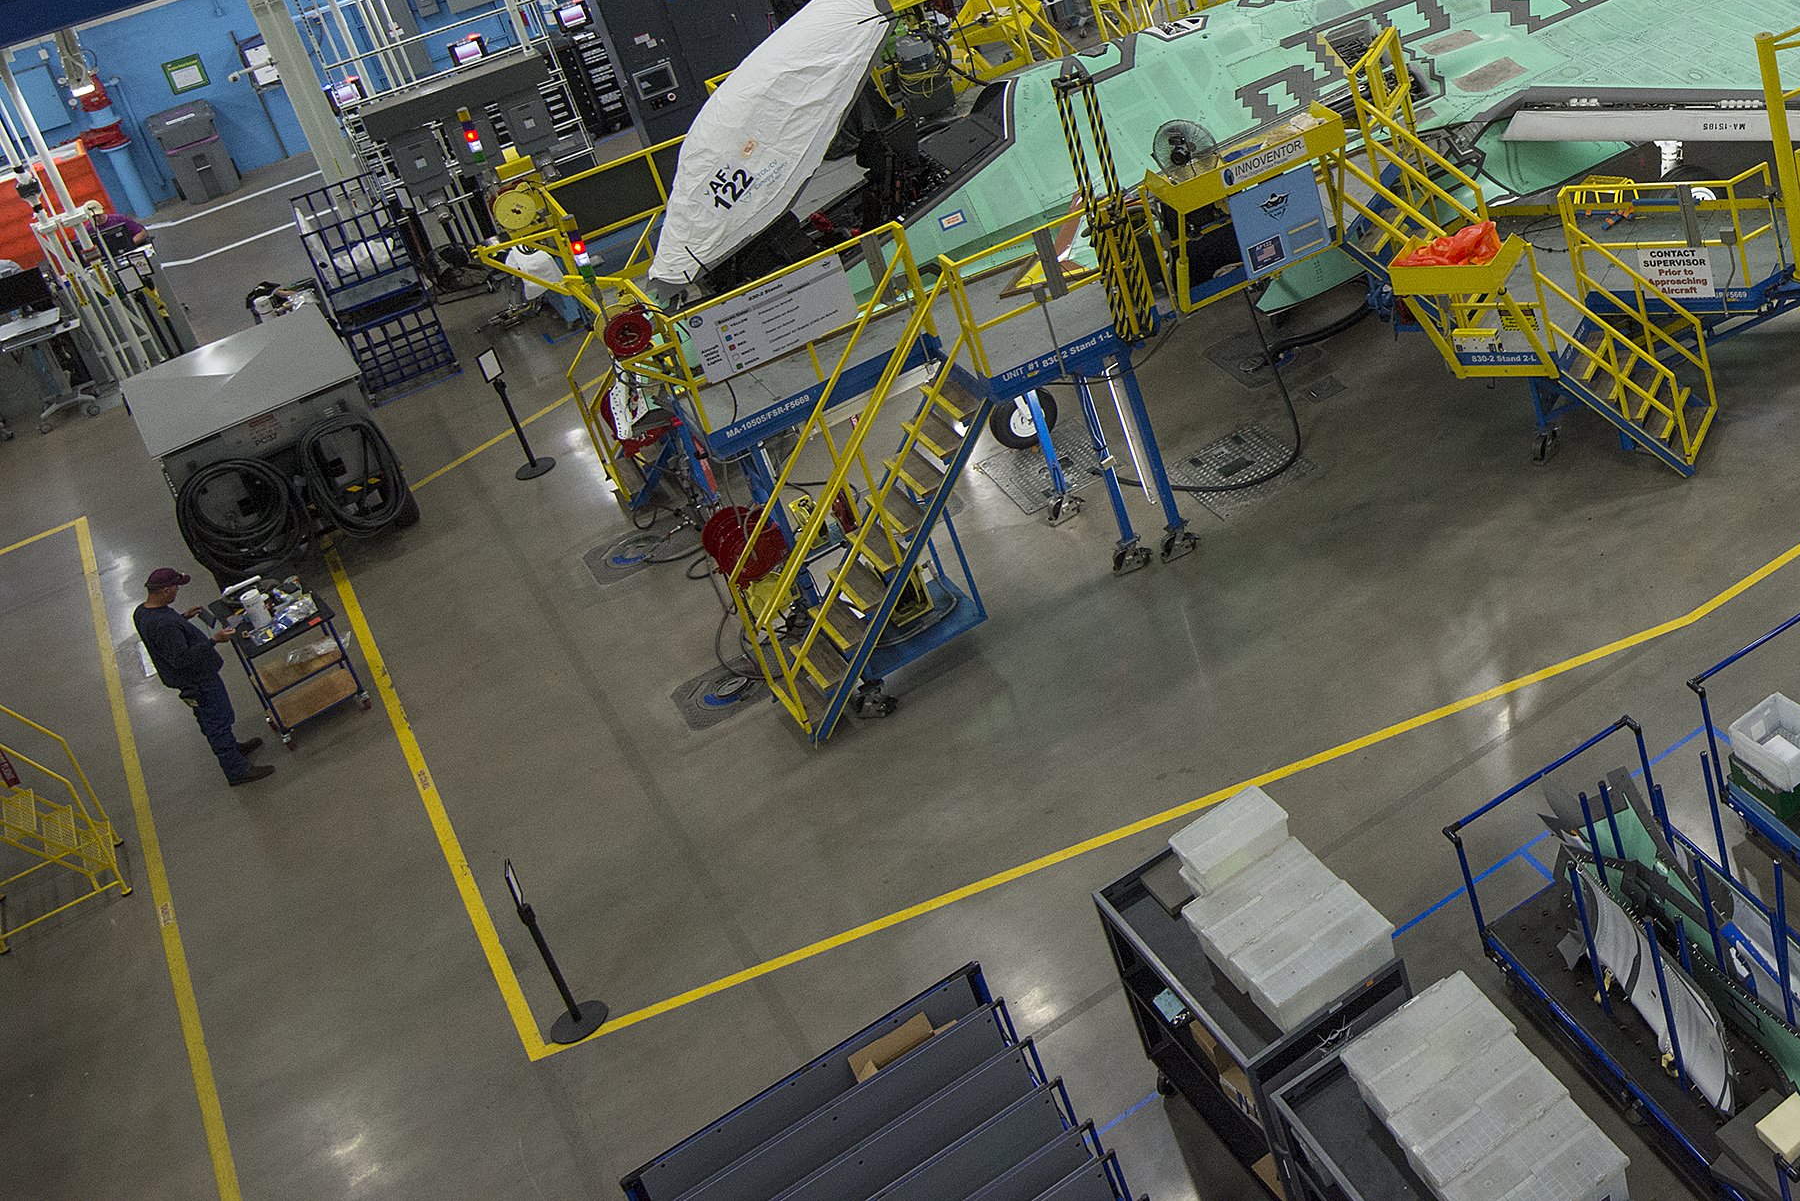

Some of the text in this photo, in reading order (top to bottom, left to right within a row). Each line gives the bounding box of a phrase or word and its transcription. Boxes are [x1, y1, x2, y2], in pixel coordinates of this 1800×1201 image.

[1234, 139, 1303, 176] INNOVENTOR
[708, 168, 730, 195] AF
[713, 168, 755, 210] 122
[1649, 249, 1697, 258] CONTACT
[1642, 258, 1707, 268] SUPERVISOR
[1658, 268, 1694, 276] Prior to
[1648, 277, 1708, 286] Approaching
[1661, 286, 1698, 294] Aircraft
[1002, 331, 1113, 383] UNIT #1 8302 Stand 1-L
[1471, 354, 1537, 363] 830-2 Stand 2-L
